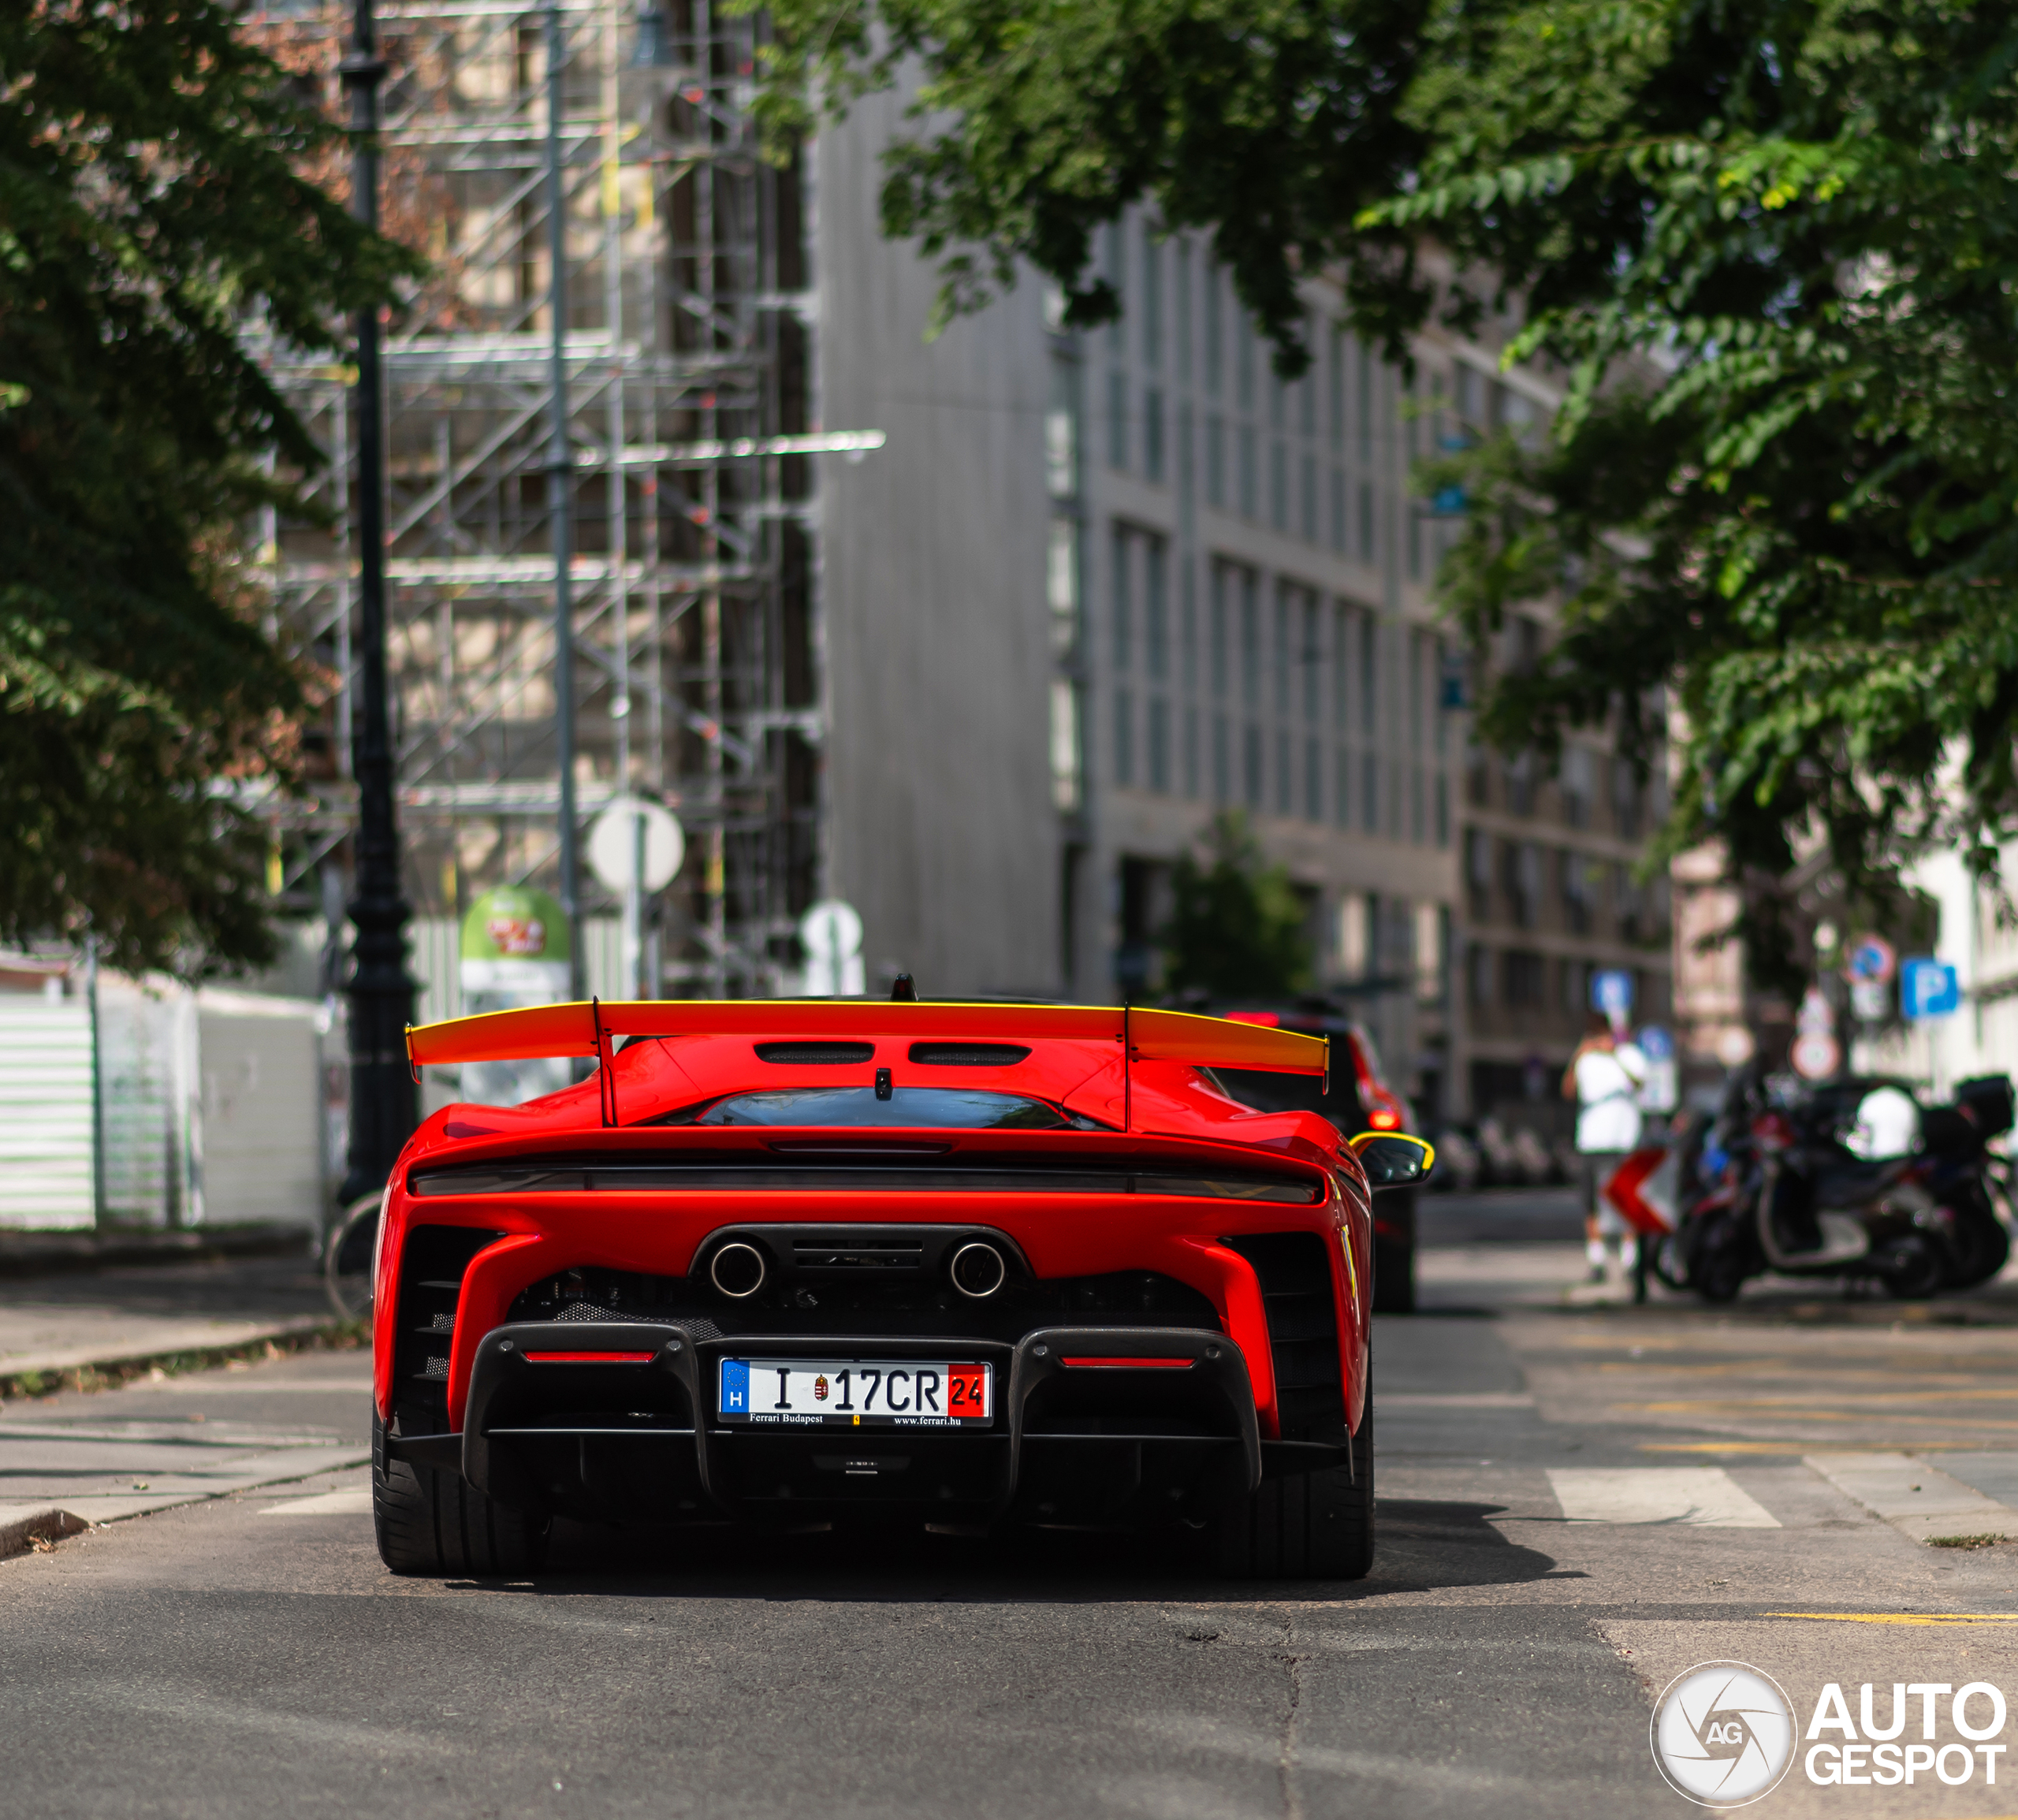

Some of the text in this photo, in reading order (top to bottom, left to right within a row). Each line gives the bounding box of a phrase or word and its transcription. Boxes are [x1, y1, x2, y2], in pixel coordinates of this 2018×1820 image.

[1916, 966, 1949, 1016] P
[835, 1368, 940, 1412] 17CR
[951, 1378, 982, 1405] 24
[730, 1391, 743, 1407] H
[750, 1413, 823, 1424] Ferrari Budapest
[894, 1416, 962, 1426] www.ferrari.hu
